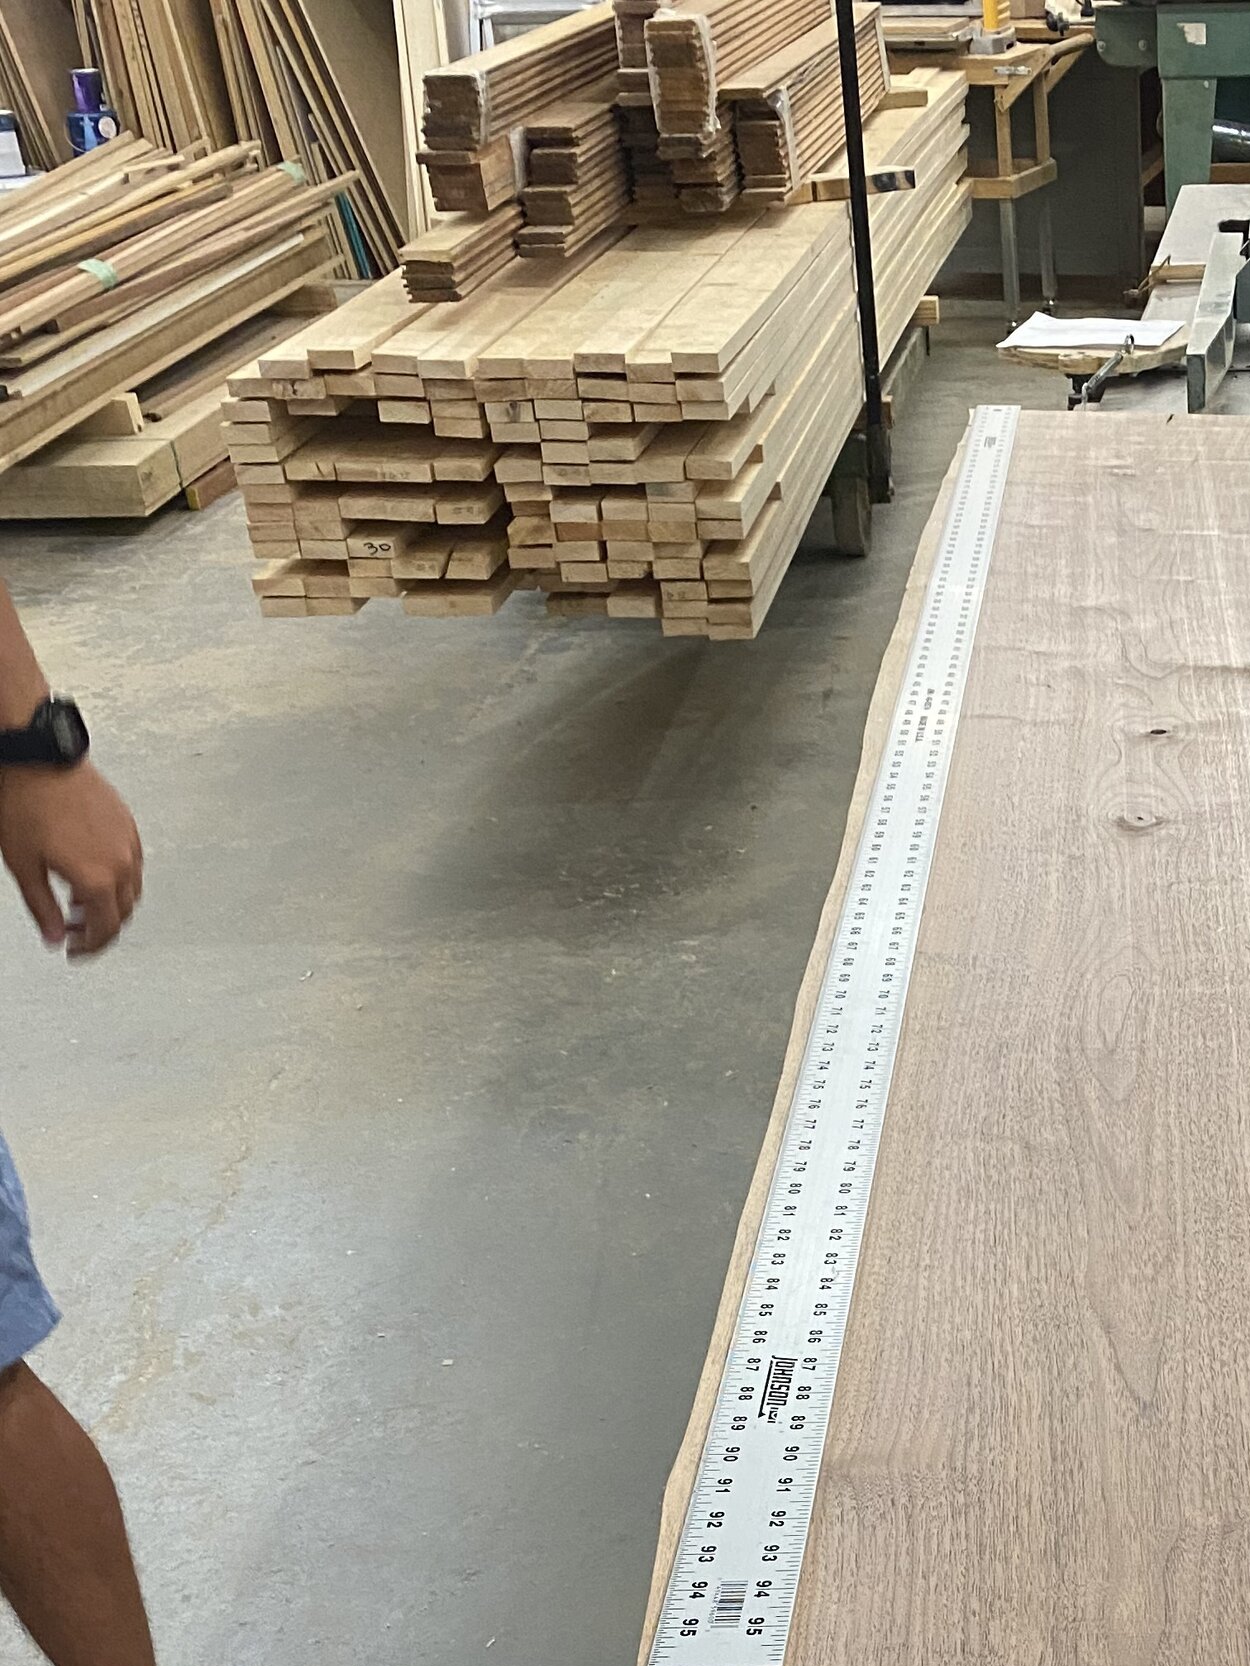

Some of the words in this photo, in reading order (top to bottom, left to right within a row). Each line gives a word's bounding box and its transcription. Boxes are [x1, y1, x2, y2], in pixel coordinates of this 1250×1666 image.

[363, 542, 391, 555] 30
[854, 912, 865, 920] 65
[847, 942, 858, 950] 67
[843, 958, 854, 966] 68
[839, 974, 851, 982] 69
[882, 974, 893, 982] 69
[835, 990, 847, 998] 70
[878, 990, 890, 998] 70
[830, 1007, 842, 1015] 71
[875, 1007, 886, 1015] 71
[826, 1025, 839, 1033] 72
[871, 1025, 883, 1033] 72
[822, 1043, 834, 1051] 73
[867, 1042, 879, 1051] 73
[817, 1061, 830, 1070] 74
[864, 1061, 876, 1070] 74
[813, 1080, 826, 1089] 75
[860, 1079, 872, 1089] 75
[808, 1100, 821, 1109] 76
[856, 1099, 868, 1109] 76
[803, 1119, 817, 1129] 77
[852, 1119, 864, 1129] 77
[799, 1140, 812, 1150] 78
[848, 1140, 860, 1150] 78
[793, 1161, 807, 1172] 79
[843, 1161, 856, 1172] 79
[788, 1183, 802, 1194] 80
[839, 1183, 852, 1194] 80
[782, 1206, 796, 1216] 81
[834, 1206, 848, 1216] 81
[777, 1229, 791, 1241] 82
[829, 1229, 843, 1241] 82
[771, 1253, 786, 1265] 83
[824, 1253, 838, 1265] 83
[765, 1278, 780, 1290] 84
[819, 1278, 833, 1290] 84
[759, 1304, 774, 1316] 85
[814, 1304, 828, 1316] 85
[752, 1330, 768, 1344] 86
[808, 1330, 822, 1343] 86
[746, 1358, 761, 1371] 87
[802, 1358, 817, 1371] 87
[766, 1355, 798, 1406] JOHNSON
[738, 1387, 754, 1401] 88
[796, 1386, 811, 1400] 88
[731, 1416, 747, 1430] 89
[790, 1415, 805, 1430] 89
[723, 1447, 740, 1462] 90
[783, 1446, 799, 1461] 90
[715, 1478, 733, 1492] 91
[776, 1478, 793, 1492] 91
[707, 1511, 724, 1528] 92
[769, 1510, 786, 1527] 92
[698, 1546, 717, 1562] 93
[762, 1545, 779, 1562] 93
[689, 1581, 708, 1599] 94
[754, 1580, 772, 1598] 94
[679, 1618, 699, 1637] 95
[746, 1617, 764, 1636] 95
